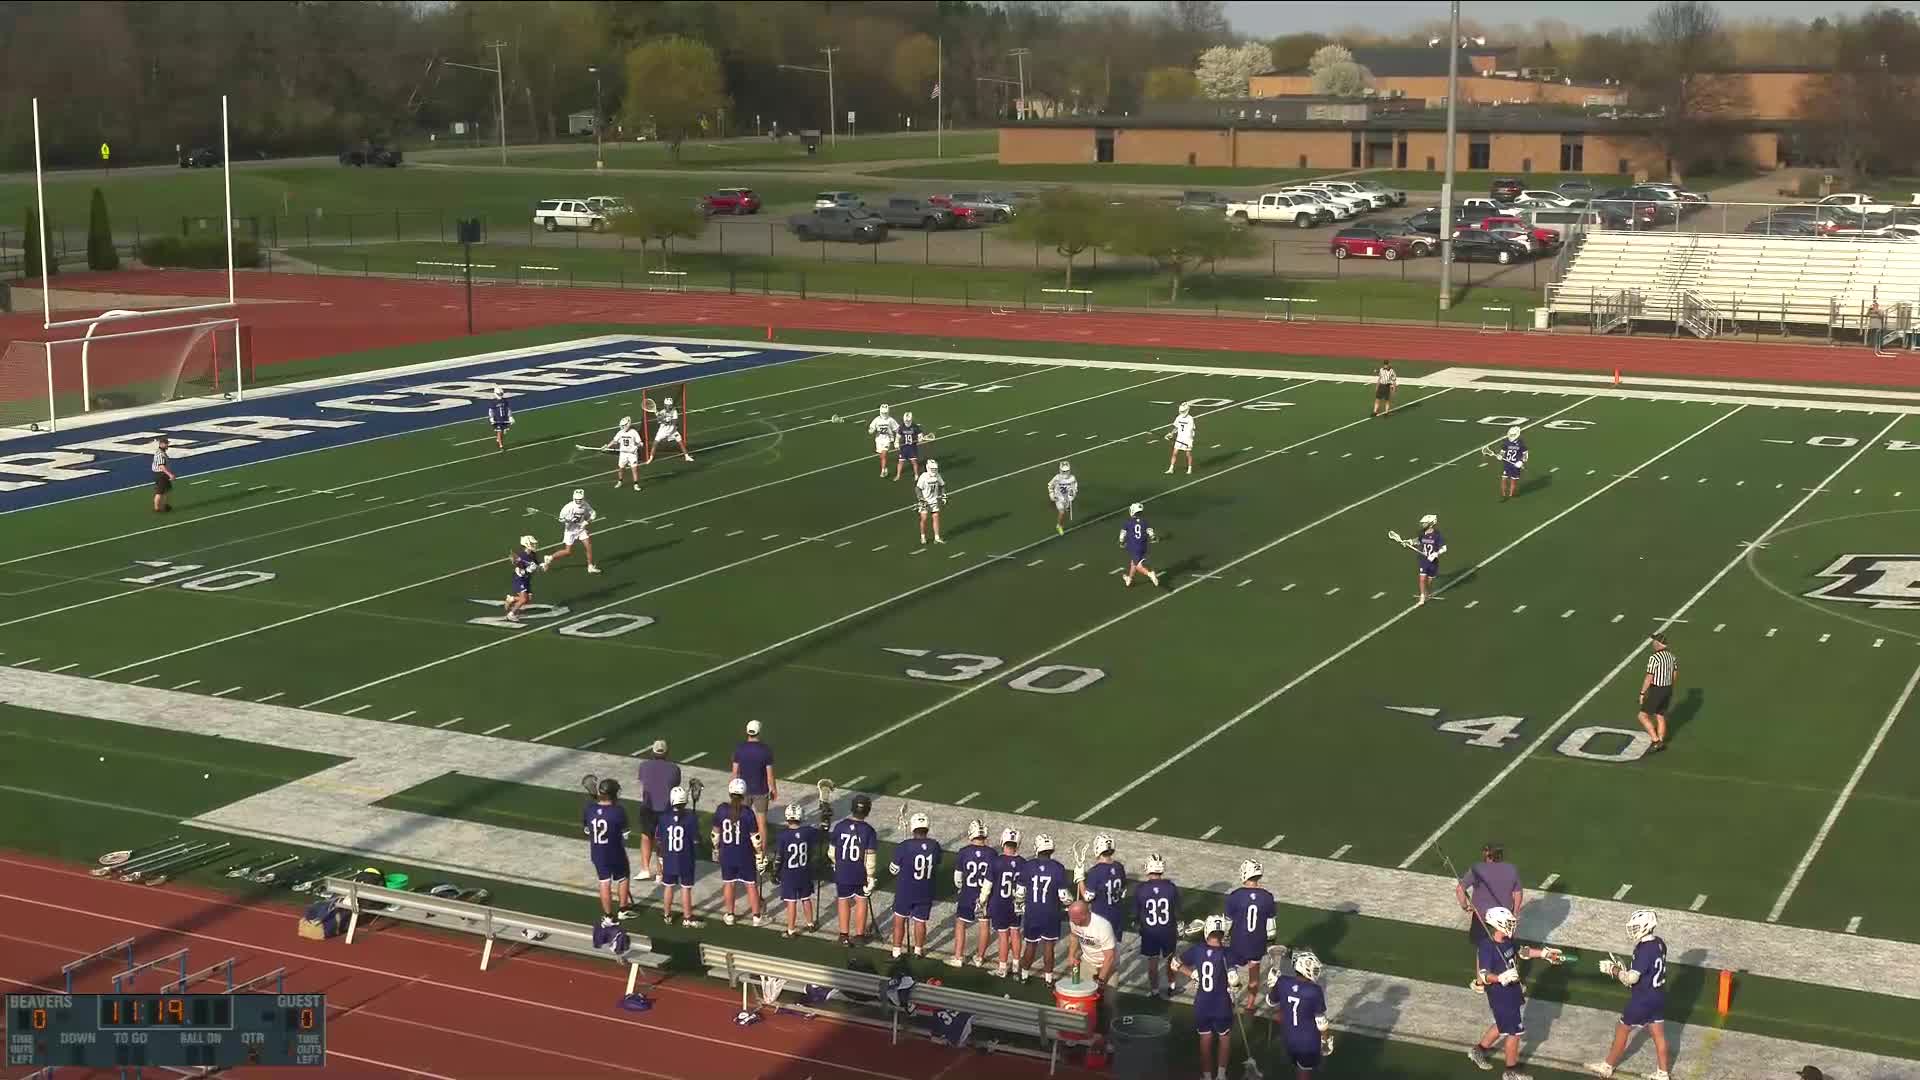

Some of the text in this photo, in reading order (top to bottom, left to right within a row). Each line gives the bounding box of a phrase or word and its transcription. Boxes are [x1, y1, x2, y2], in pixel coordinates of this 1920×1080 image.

[315, 346, 762, 412] CREEK
[904, 434, 912, 445] 19
[1506, 449, 1516, 461] 52
[1133, 524, 1142, 539] 9
[120, 564, 276, 592] 10
[467, 603, 656, 638] 20
[905, 653, 1105, 694] 30
[1437, 715, 1657, 763] 40
[591, 818, 608, 844] 12
[667, 825, 684, 852] 18
[722, 818, 739, 845] 81
[787, 842, 806, 869] 28
[840, 833, 859, 861] 76
[914, 853, 933, 880] 91
[966, 861, 988, 887] 23
[1031, 875, 1051, 903] 17
[1145, 897, 1169, 926] 33
[1247, 904, 1256, 932] 0
[1201, 961, 1213, 992] 8
[1652, 957, 1666, 988] 2
[1287, 995, 1299, 1026] 7
